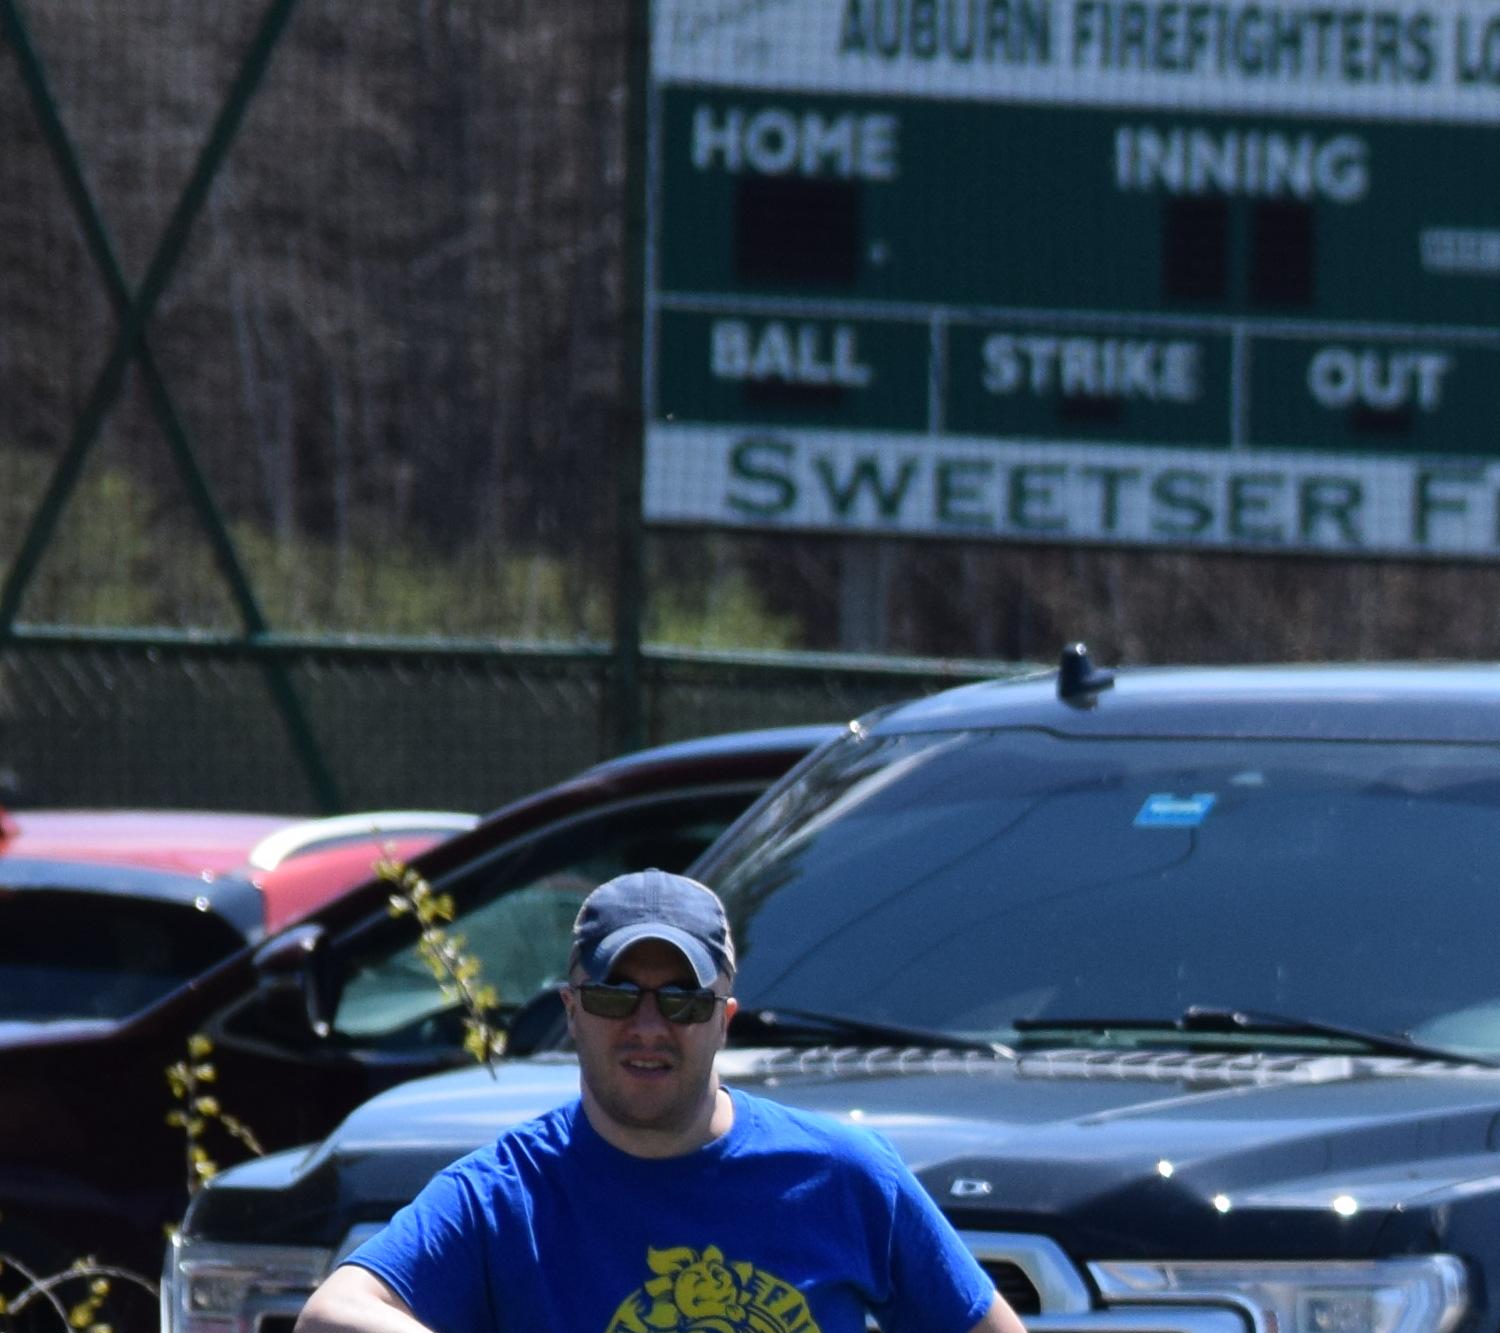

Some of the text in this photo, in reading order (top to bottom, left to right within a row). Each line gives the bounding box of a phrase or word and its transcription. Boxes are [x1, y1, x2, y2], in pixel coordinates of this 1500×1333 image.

[836, 0, 1052, 66] AUBURN
[1070, 2, 1436, 84] FIREFIGHTERS
[690, 104, 900, 182] HOME
[1111, 122, 1370, 202] INNING
[708, 318, 874, 388] BALL
[978, 333, 1204, 403] STRIKE
[1306, 346, 1455, 412] OUT
[724, 435, 1366, 546] SWEETSER
